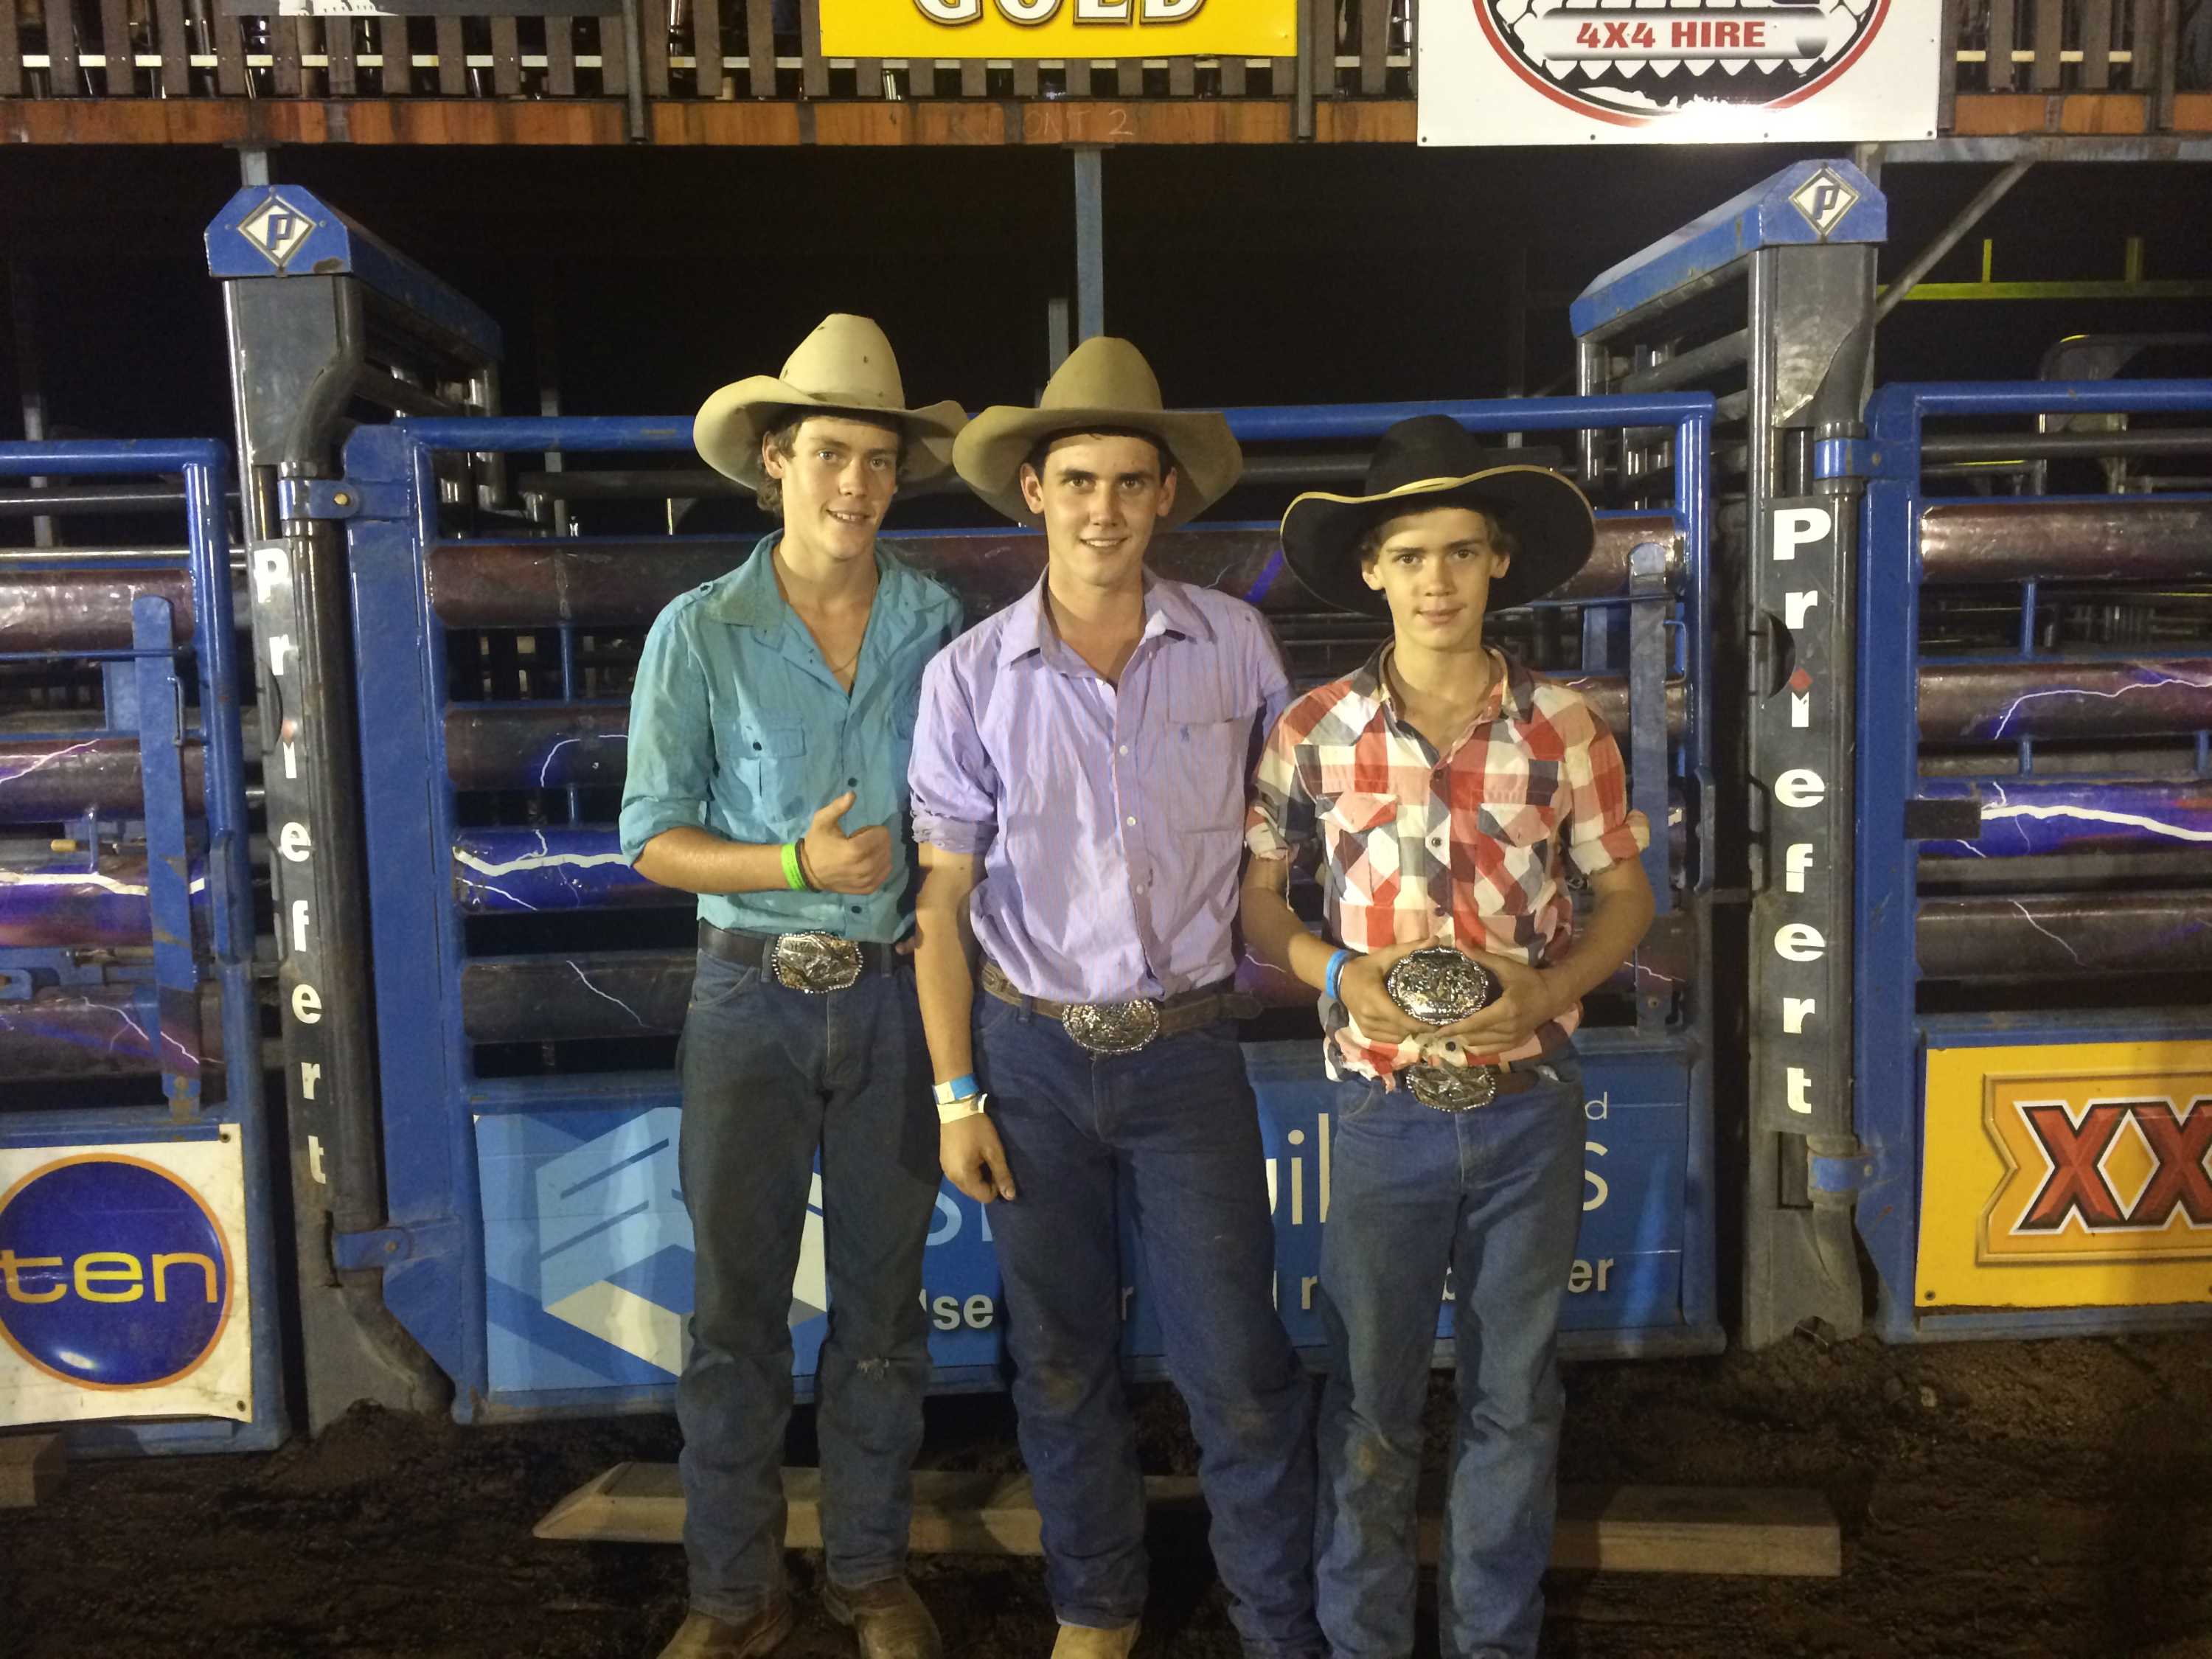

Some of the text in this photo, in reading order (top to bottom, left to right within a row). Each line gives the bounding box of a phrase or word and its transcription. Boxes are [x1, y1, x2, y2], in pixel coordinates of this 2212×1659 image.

[1576, 21, 1766, 49] 4X4 HIRE
[0, 1249, 218, 1304] ten
